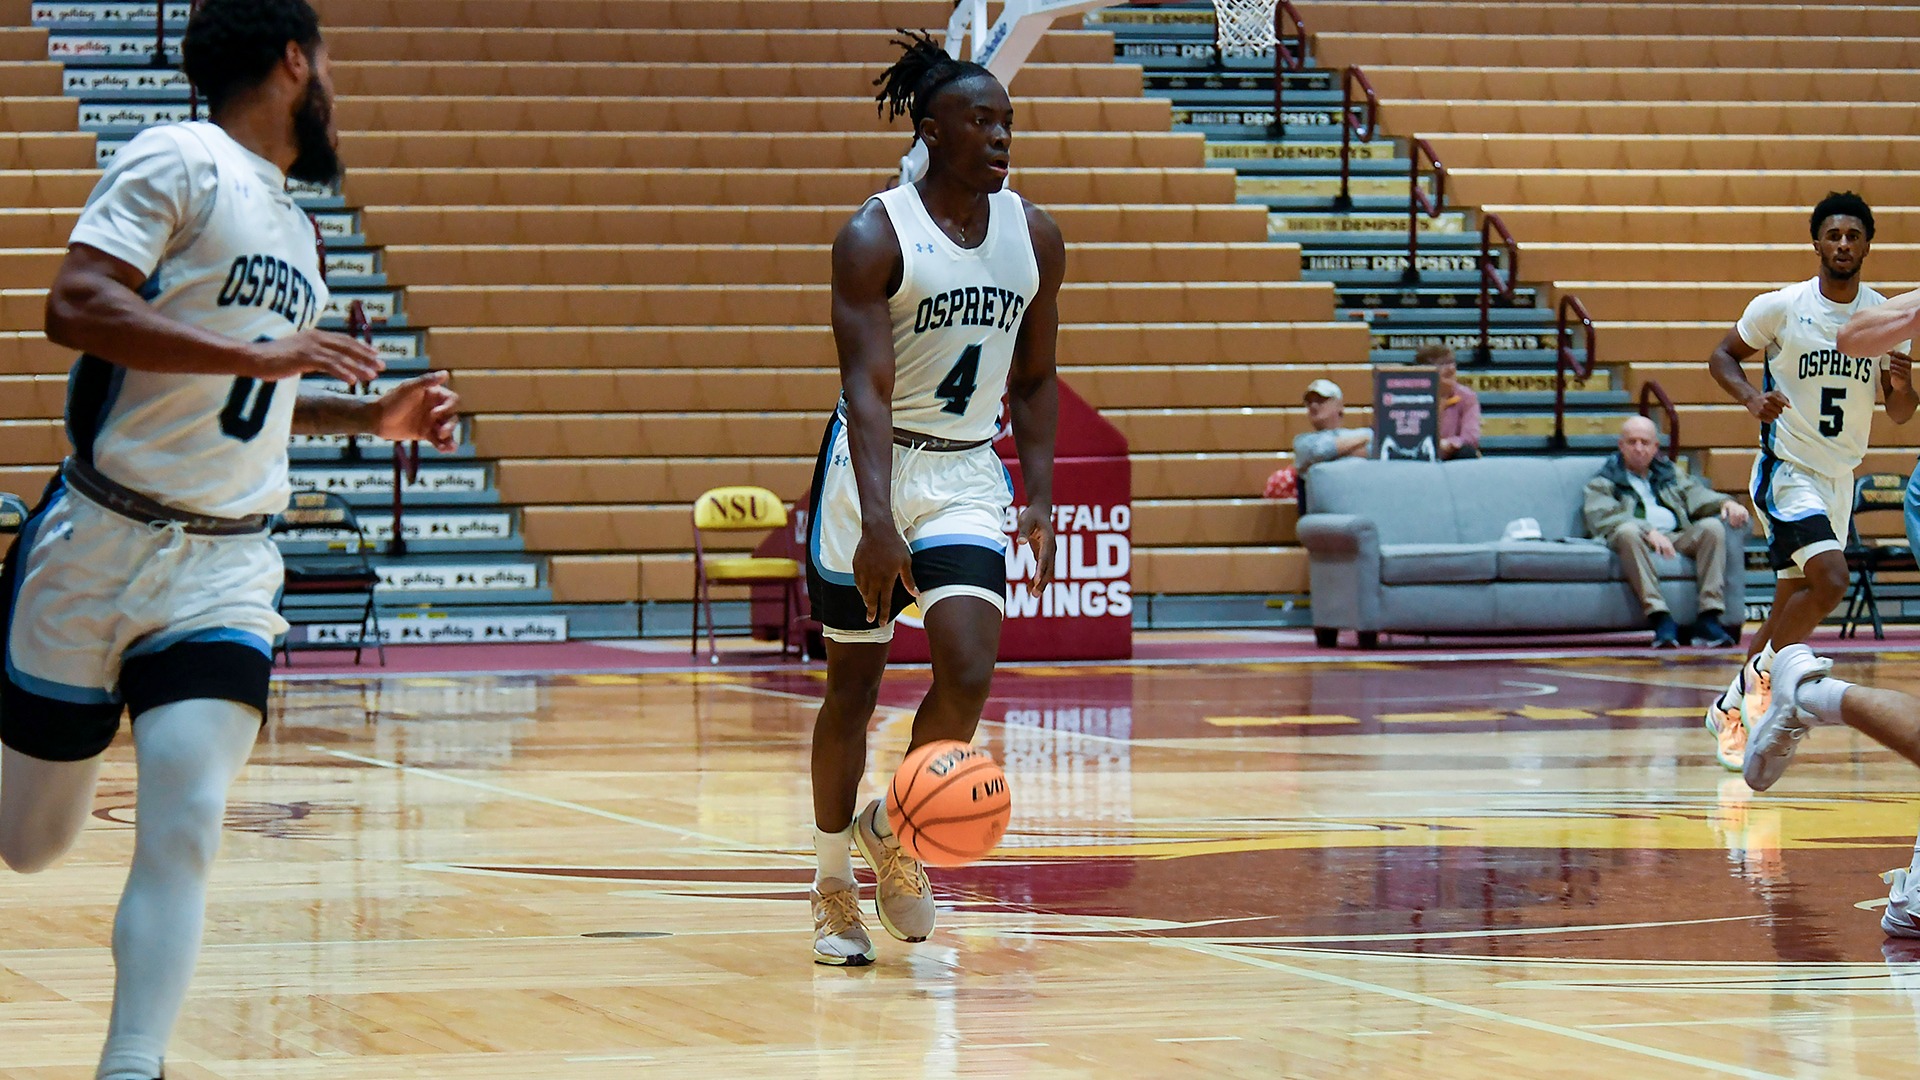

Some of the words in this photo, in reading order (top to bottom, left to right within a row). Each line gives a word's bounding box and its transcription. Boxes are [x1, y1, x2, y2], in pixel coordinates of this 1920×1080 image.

[1272, 146, 1372, 159] DEMPSYS
[1341, 218, 1430, 231] DEMPSES
[217, 254, 316, 332] OSPREY
[914, 286, 1024, 334] OSPREYS
[934, 343, 983, 416] 4
[1479, 375, 1586, 390] DEMPSES
[1798, 349, 1872, 384] OSPREYS
[1818, 387, 1846, 438] 5
[709, 494, 769, 522] NSU
[1002, 504, 1131, 532] BFALO
[1005, 533, 1131, 580] WILD
[1005, 580, 1133, 618] WINGS
